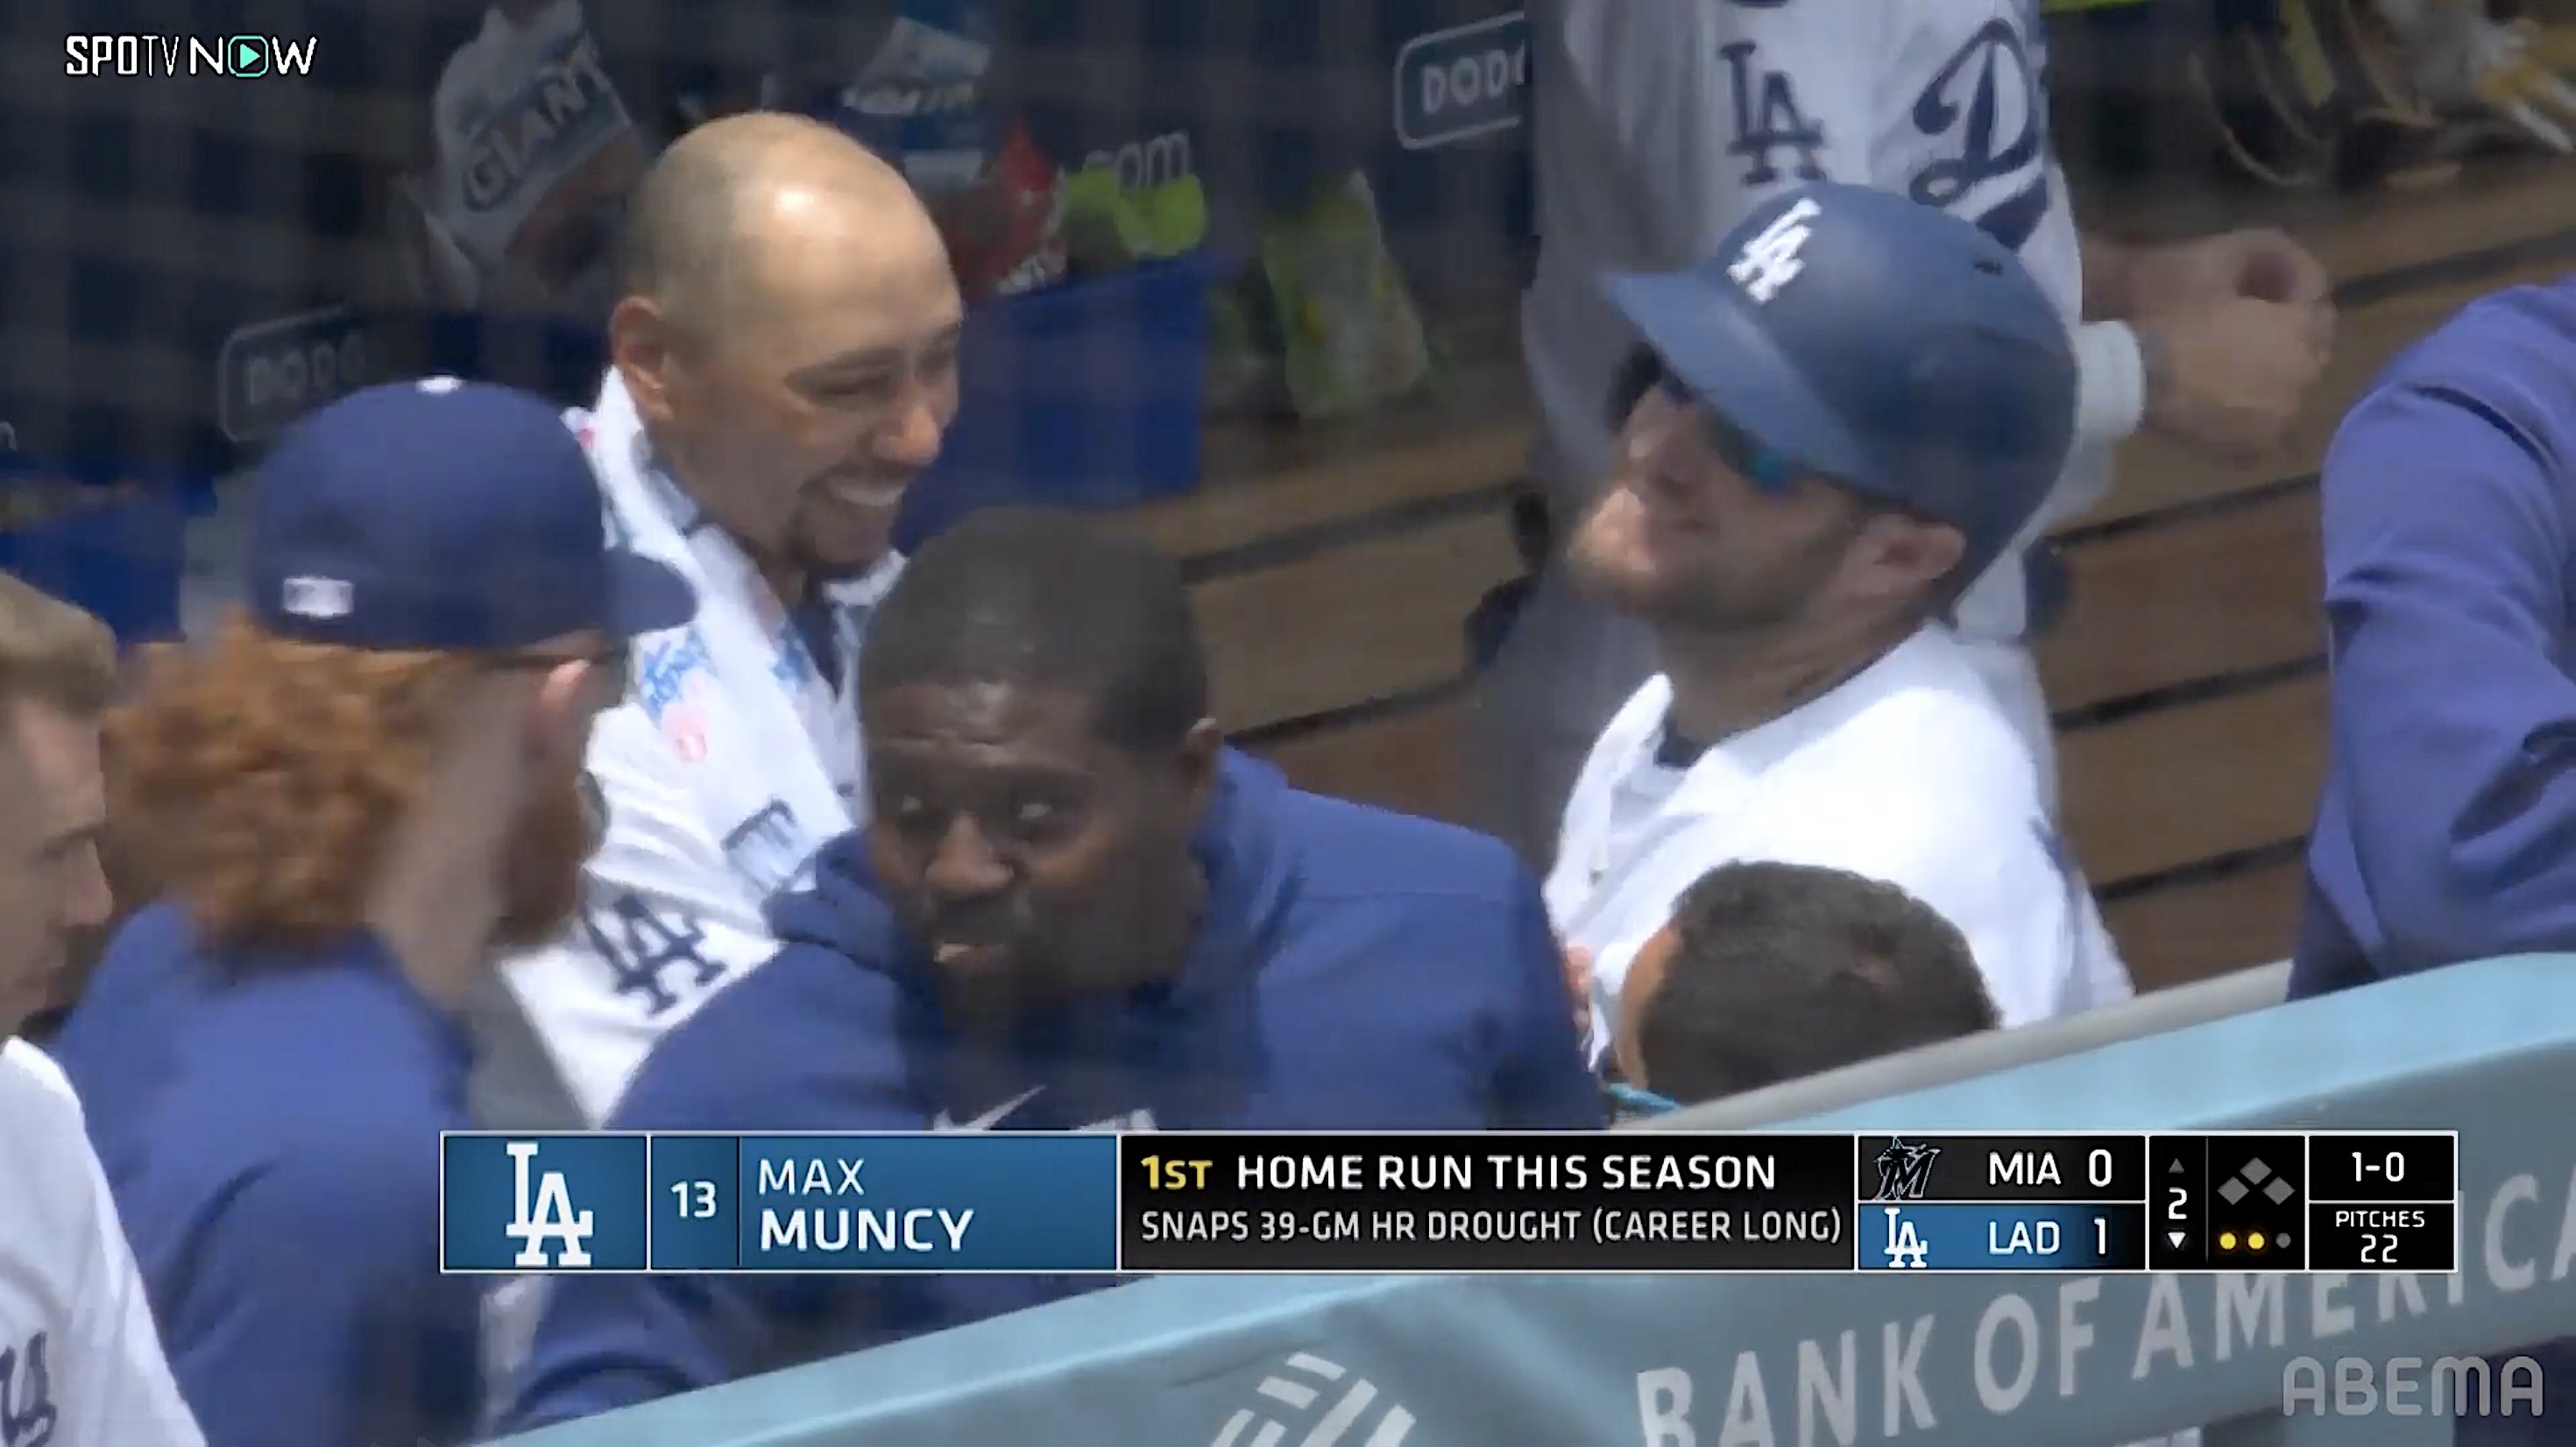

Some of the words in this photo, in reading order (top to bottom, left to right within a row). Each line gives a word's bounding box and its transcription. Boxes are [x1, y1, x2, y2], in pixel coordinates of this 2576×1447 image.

[1725, 198, 1822, 307] LA
[1637, 1314, 1938, 1447] BANK
[1974, 1276, 2102, 1415] OF
